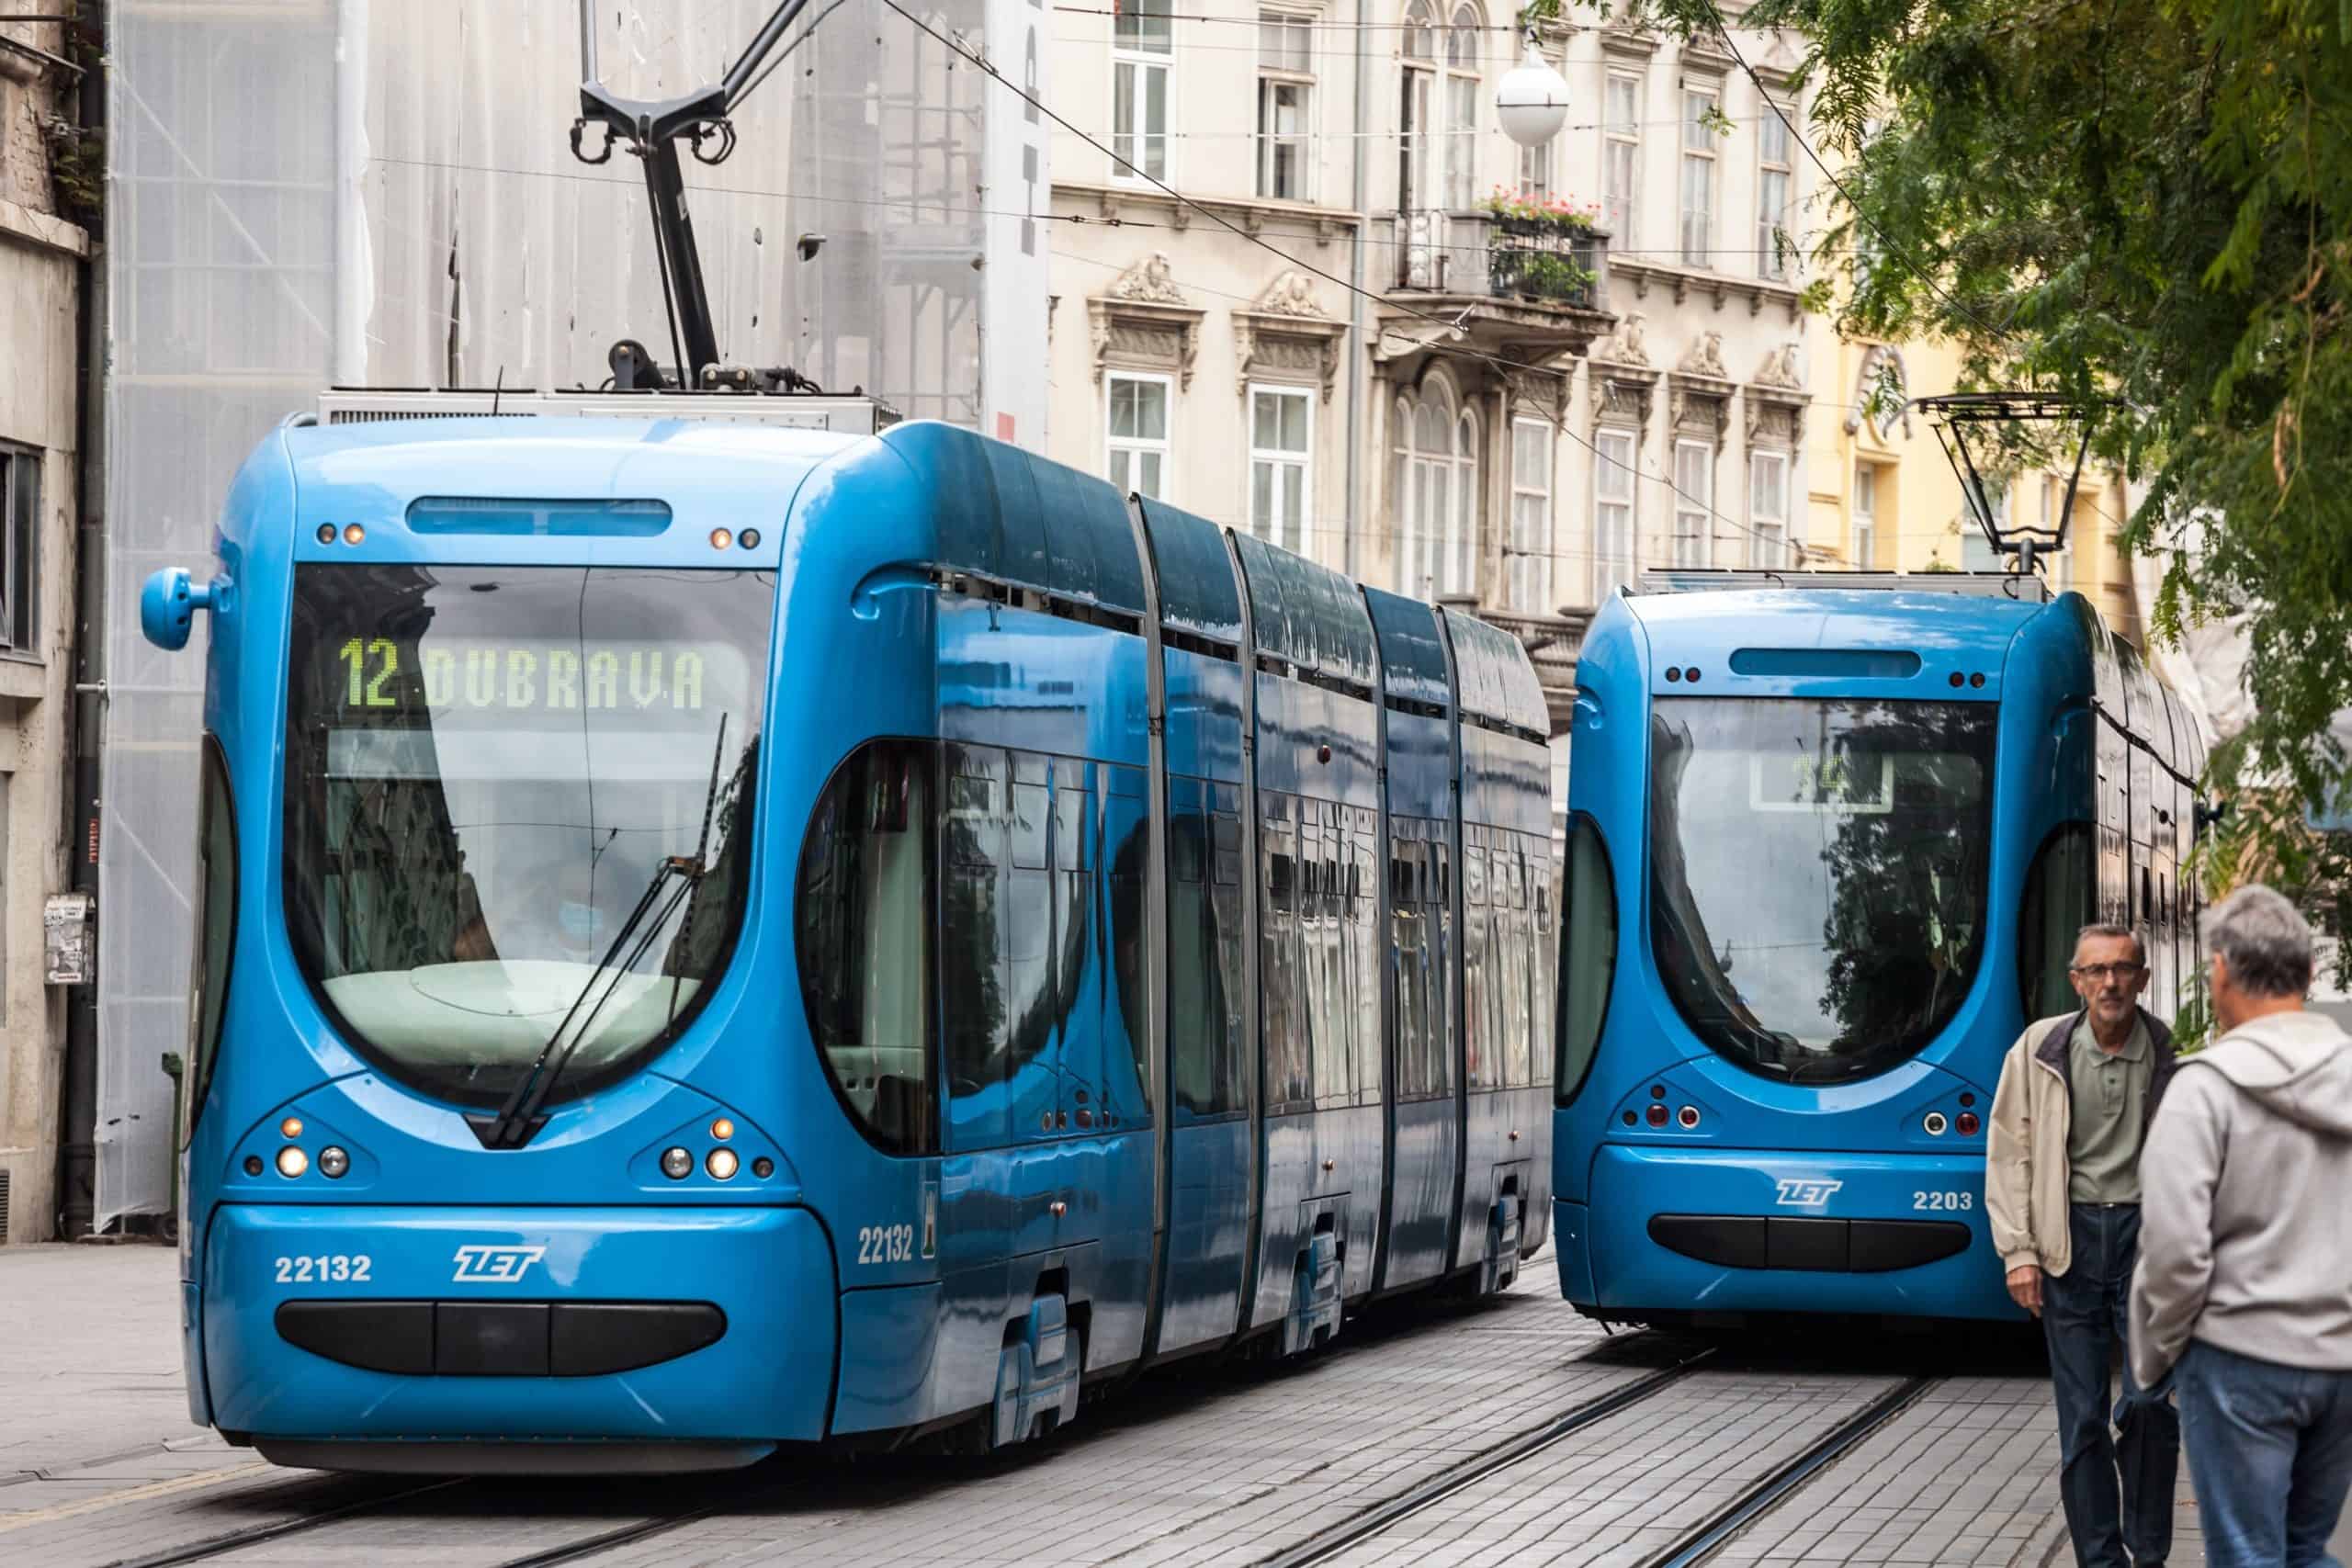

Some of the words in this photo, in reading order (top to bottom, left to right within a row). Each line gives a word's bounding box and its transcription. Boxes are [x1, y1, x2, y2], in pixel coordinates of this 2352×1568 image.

[340, 637, 398, 706] 12
[424, 646, 705, 709] DUBRAVA
[1776, 1179, 1843, 1205] ZET
[1913, 1190, 1972, 1210] 2203
[858, 1224, 912, 1264] 22132
[275, 1255, 371, 1282] 22132
[453, 1246, 547, 1281] ZET
